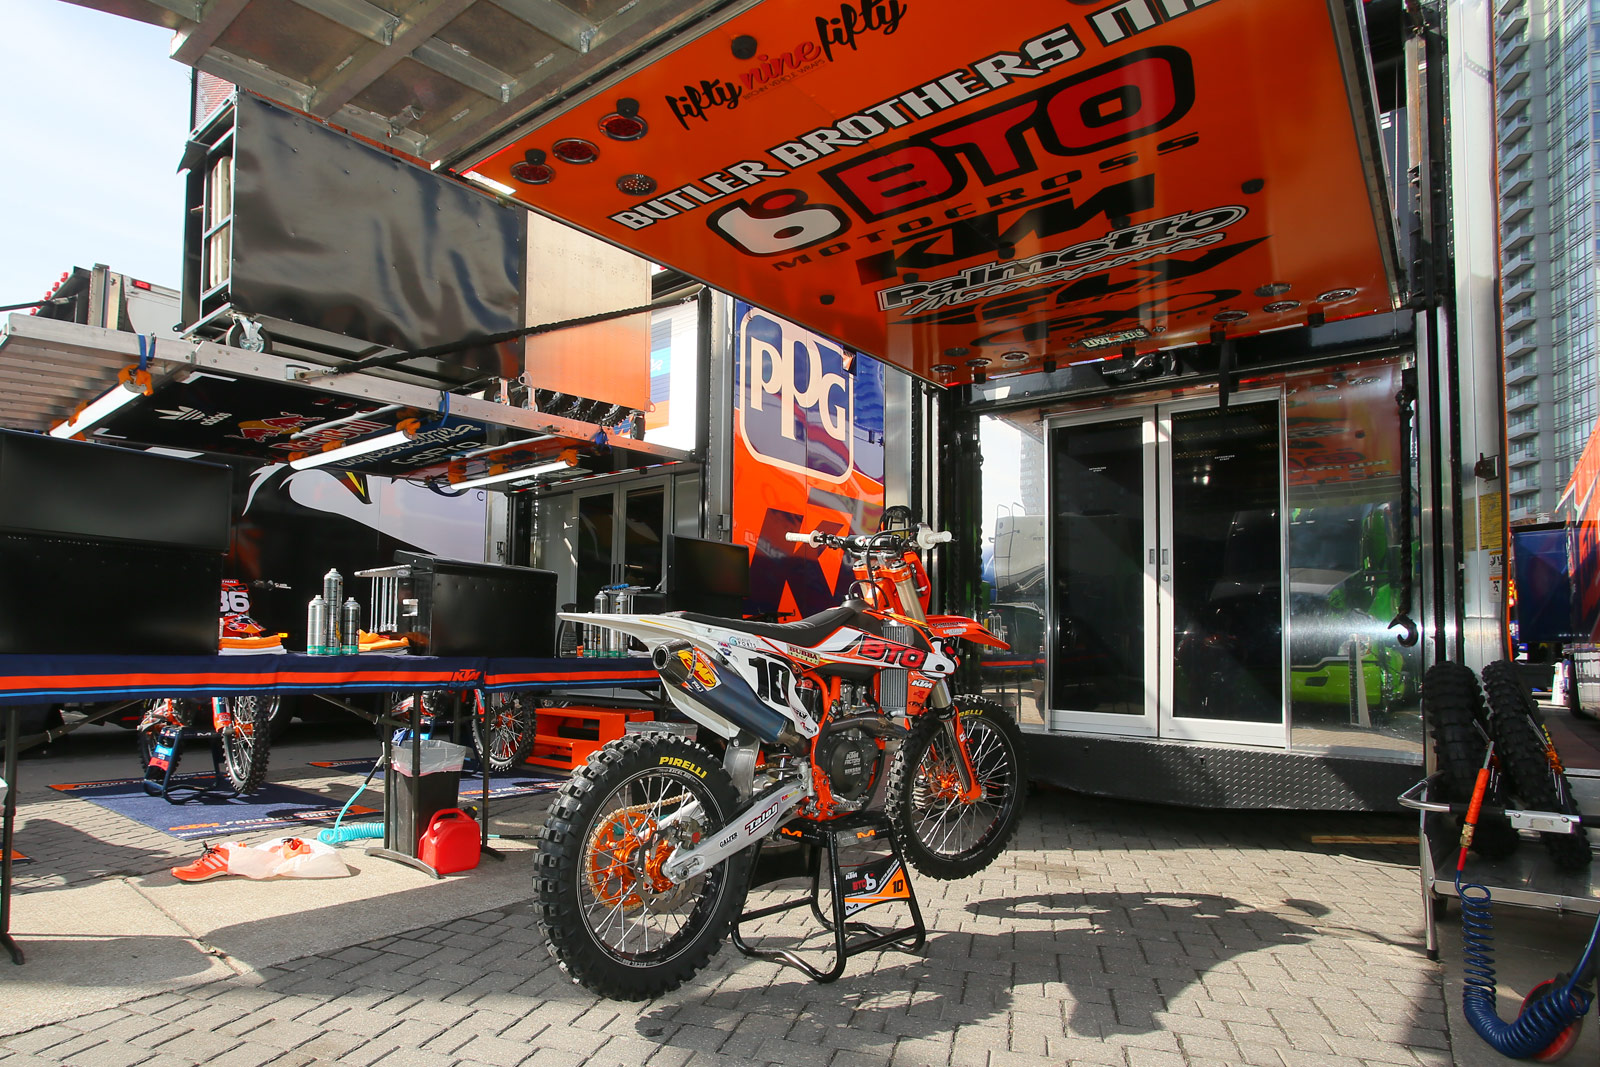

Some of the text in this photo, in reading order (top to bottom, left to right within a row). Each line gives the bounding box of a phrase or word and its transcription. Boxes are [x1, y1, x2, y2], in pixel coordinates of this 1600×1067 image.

[665, 0, 908, 131] fifty nine fifty
[608, 159, 789, 230] BUTLER
[769, 27, 1082, 169] BROTHERS
[824, 49, 1187, 221] BTO
[772, 131, 1199, 271] MOTOCROSS
[855, 172, 1155, 286] KTM
[877, 205, 1249, 312] Palmetto
[901, 233, 1227, 316] Motorsports
[751, 318, 846, 441] PPG
[200, 410, 232, 426] adidas
[391, 441, 481, 465] GoPro
[860, 637, 926, 669] BTO
[451, 669, 481, 682] KTM
[911, 679, 934, 689] KTM
[959, 709, 984, 717] RELLI
[658, 756, 708, 779] PIRELLI
[745, 802, 778, 835] Talon
[719, 832, 738, 848] GALFER
[892, 879, 904, 893] 10
